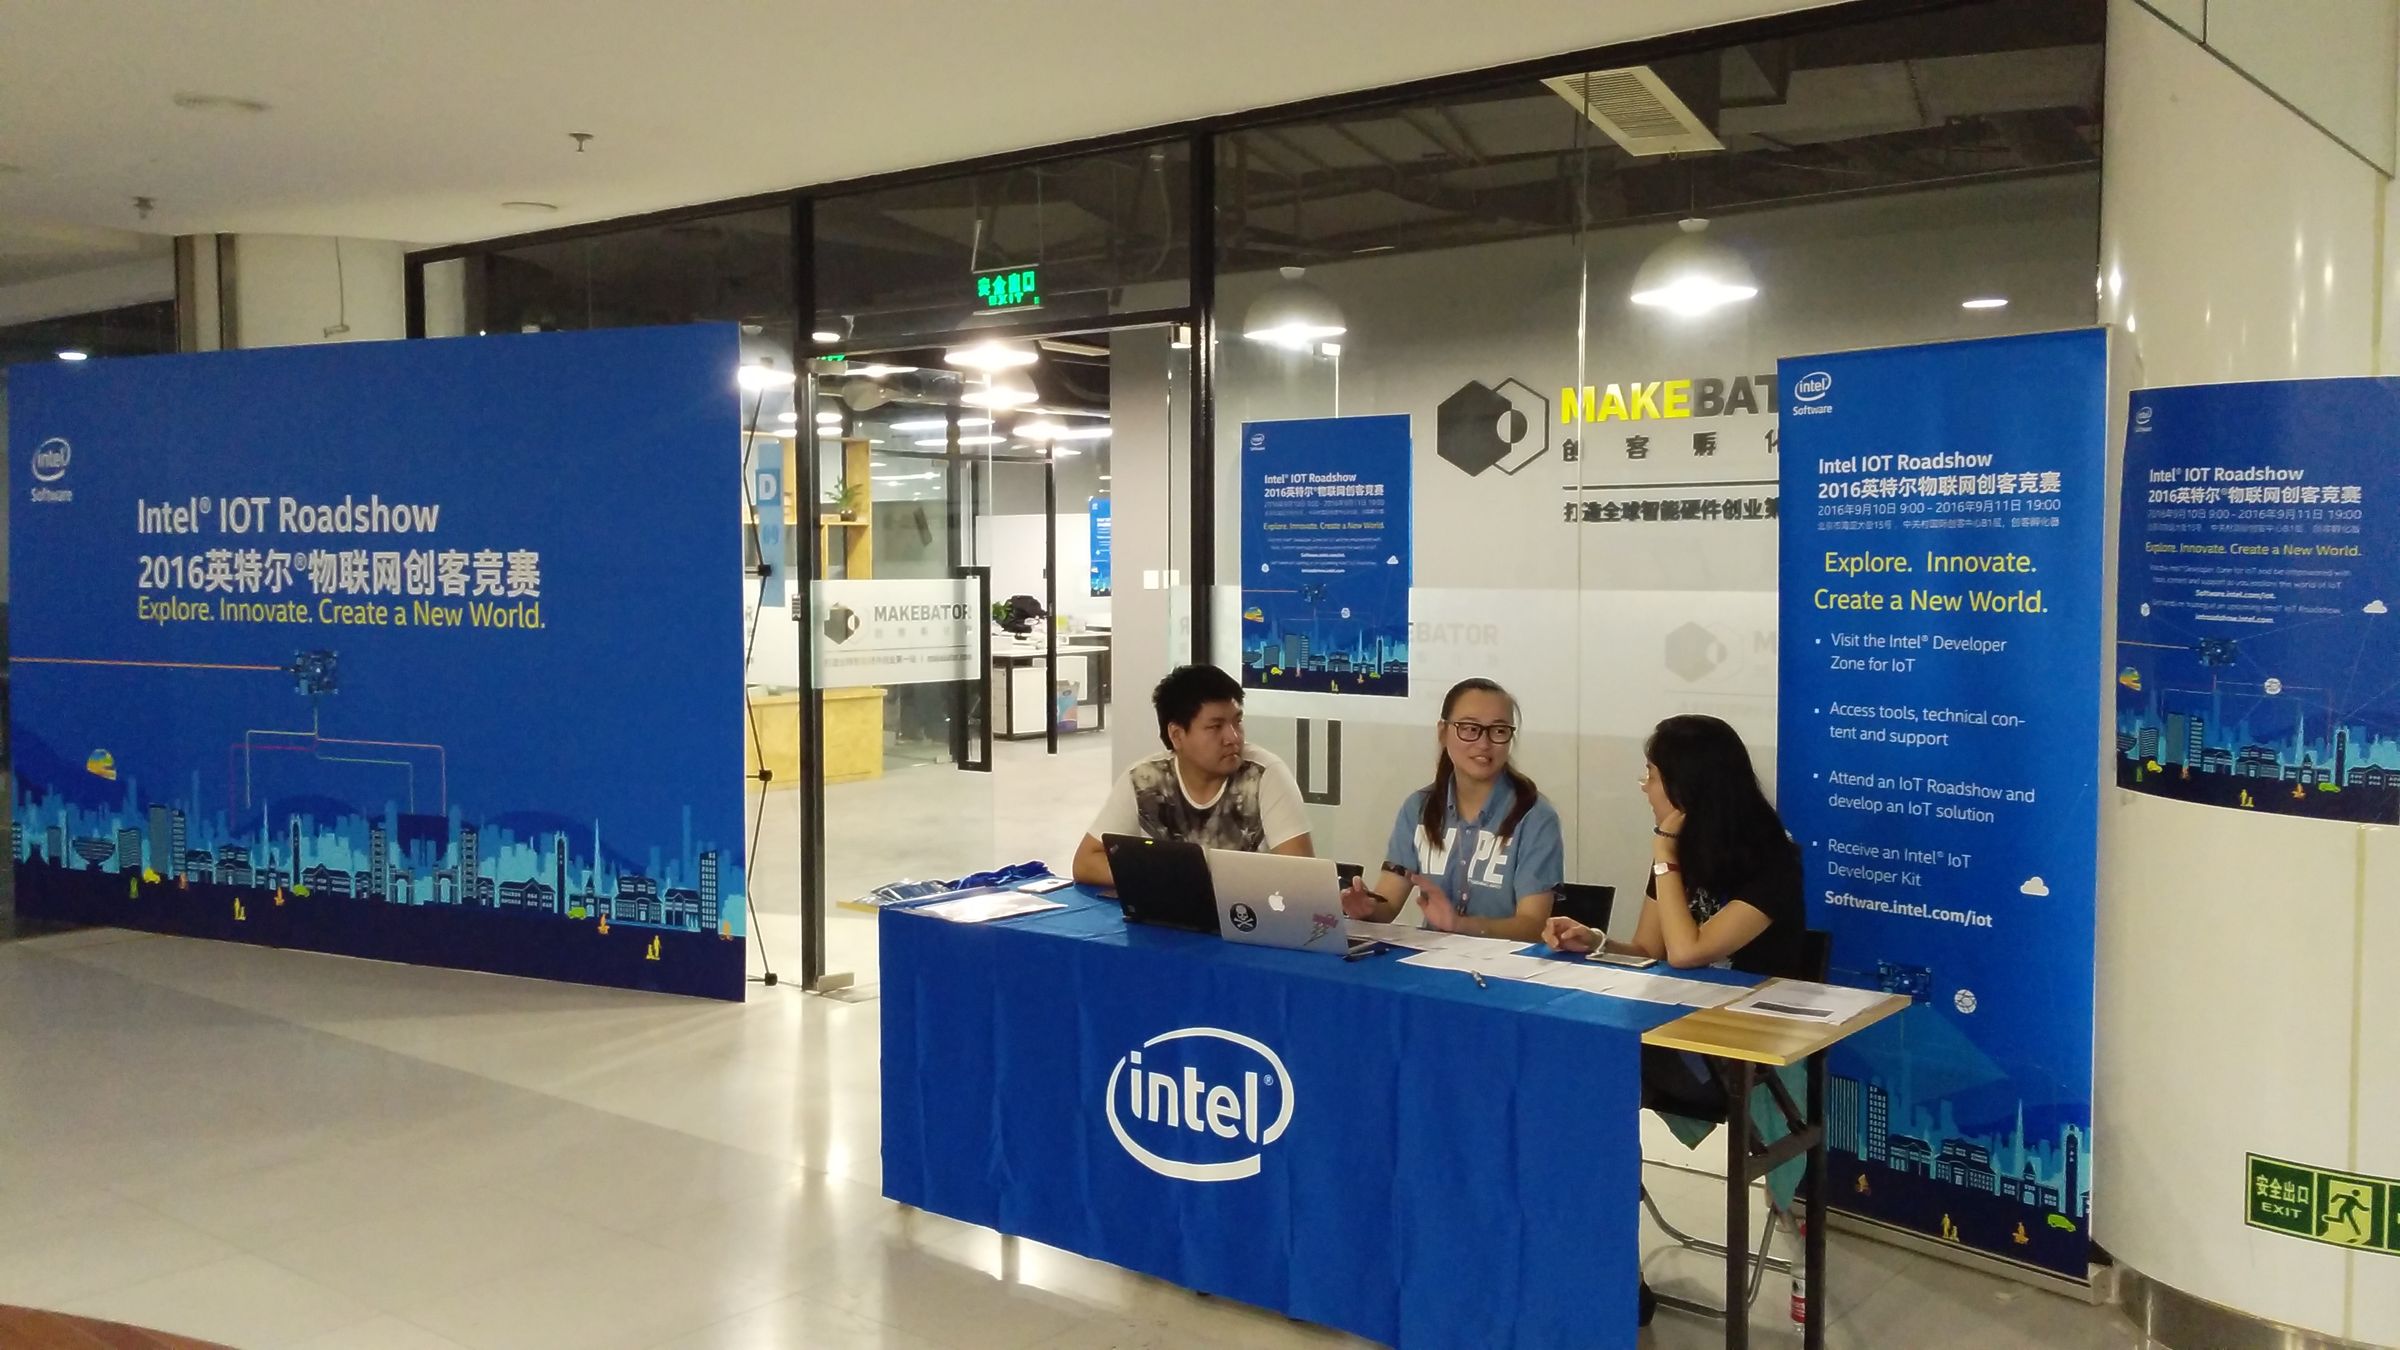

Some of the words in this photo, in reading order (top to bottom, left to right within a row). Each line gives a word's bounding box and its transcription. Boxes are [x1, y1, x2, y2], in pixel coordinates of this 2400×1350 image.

[1799, 377, 1825, 392] intel
[1561, 374, 1779, 424] MAKEBAT
[1793, 404, 1833, 416] Software
[1819, 458, 1856, 474] Intel
[1862, 455, 1894, 472] IOT
[1897, 451, 1993, 470] Roadshow
[2184, 467, 2211, 481] IOT
[2214, 466, 2304, 481] Roadshow
[1290, 473, 1307, 483] IOT
[1309, 471, 1357, 483] Roadshow
[220, 497, 271, 533] IOT
[279, 494, 440, 533] Roadshow
[1899, 503, 1924, 514] 9:00
[2026, 498, 2061, 511] 19:00
[2230, 543, 2269, 555] Create
[2272, 546, 2279, 555] a
[2283, 544, 2312, 556] New
[2316, 545, 2363, 556] World.
[138, 547, 541, 598] 2016英特尔®物联网创客竞赛
[1825, 551, 1913, 577] Explore.
[1927, 551, 2037, 573] Innovate.
[138, 595, 214, 626] Explore.
[220, 597, 313, 624] Innovate.
[319, 598, 388, 625] Create
[394, 607, 407, 625] a
[413, 600, 463, 626] New
[469, 601, 546, 629] World.
[1814, 588, 1884, 610] Create
[1890, 593, 1903, 610] a
[1910, 590, 1962, 612] New
[1968, 590, 2048, 613] World.
[1831, 633, 1860, 647] Visit
[1863, 634, 1885, 648] the
[1932, 635, 2006, 653] Developer
[1830, 656, 1865, 670] Zone
[1868, 656, 1888, 671] for
[1892, 658, 1916, 672] IoT
[1830, 702, 1876, 718] Access
[1879, 704, 1919, 722] tools,
[1922, 707, 1988, 726] technical
[1991, 713, 2026, 727] con-
[1830, 727, 1856, 740] tent
[1859, 728, 1886, 742] and
[1889, 733, 1949, 747] support
[1829, 770, 1874, 788] Attend
[1878, 777, 1895, 789] an
[1899, 776, 1922, 792] IoT
[1927, 779, 2003, 800] Roadshow
[2006, 788, 2035, 803] and
[1829, 793, 1883, 813] develop
[1887, 801, 1904, 815] an
[1908, 802, 1932, 816] IoT
[1936, 805, 1994, 823] solution
[1828, 839, 1879, 857] Receive
[1883, 847, 1899, 860] an
[1948, 853, 1971, 869] IoT
[1828, 862, 1897, 884] Developer
[1902, 872, 1921, 886] Kit
[1825, 890, 1993, 928] Software.intel.com/iot
[2256, 1174, 2309, 1205] 安全出口
[2261, 1202, 2302, 1219] EXIT
